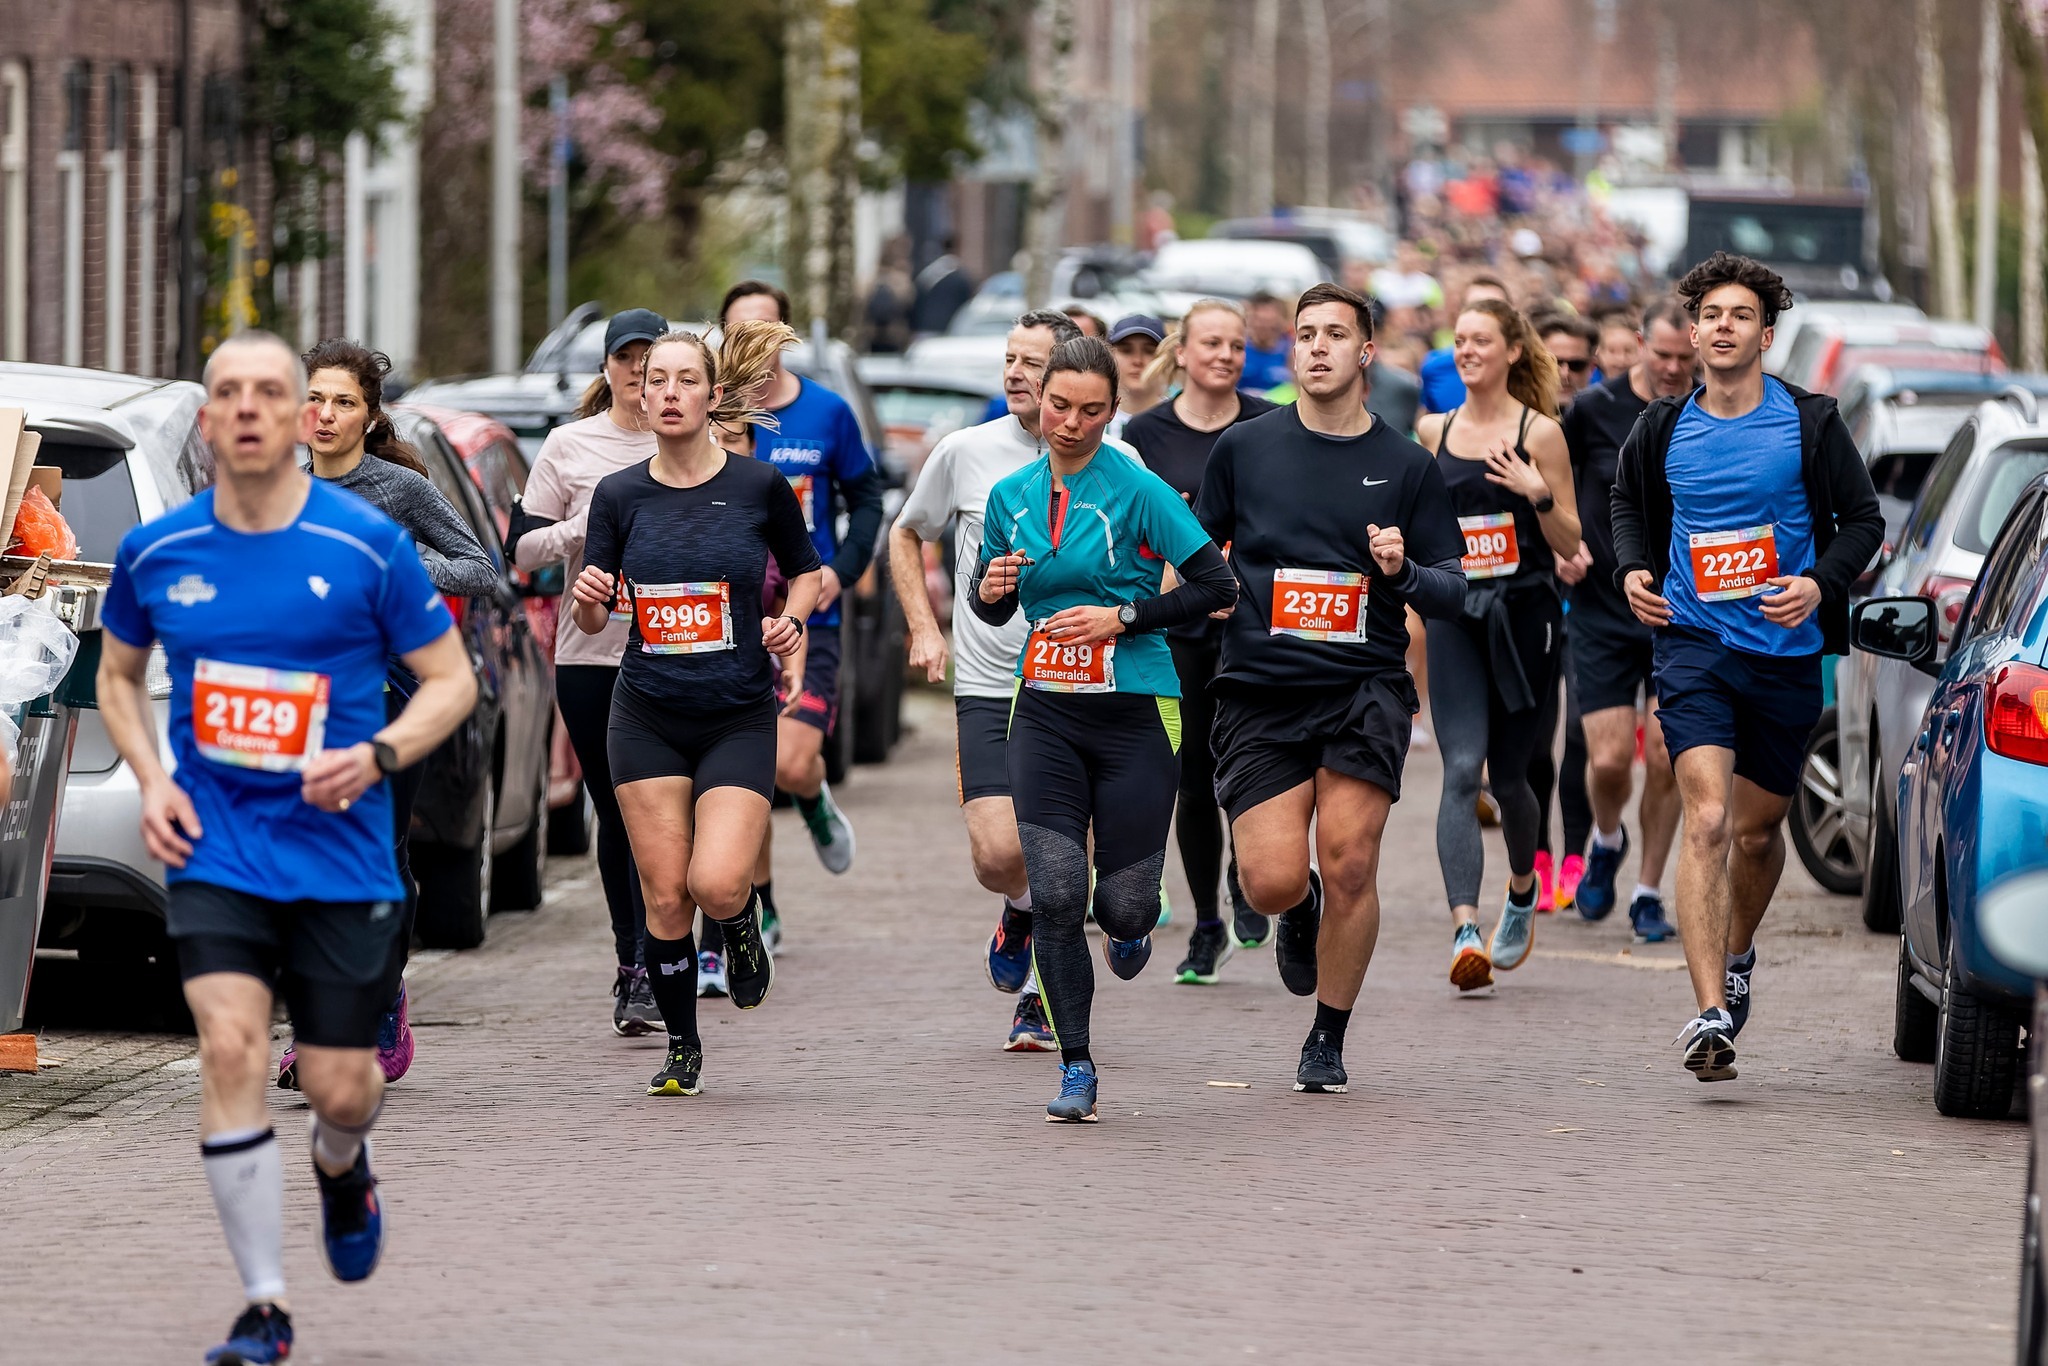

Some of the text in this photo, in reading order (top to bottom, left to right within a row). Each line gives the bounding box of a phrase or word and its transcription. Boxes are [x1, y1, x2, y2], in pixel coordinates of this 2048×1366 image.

[769, 447, 822, 466] KPMG
[1465, 532, 1507, 557] 080
[1460, 554, 1505, 568] Frederike
[1701, 547, 1768, 577] 2222
[1719, 573, 1756, 590] Andrei
[618, 601, 633, 613] Ma
[1283, 590, 1349, 617] 2375
[646, 603, 711, 629] 2996
[1299, 616, 1332, 629] Collin
[661, 629, 698, 642] Femke
[1033, 640, 1092, 668] 2789
[1034, 667, 1091, 682] Esmeralda
[205, 691, 298, 737] 2129
[15, 737, 41, 777] ore
